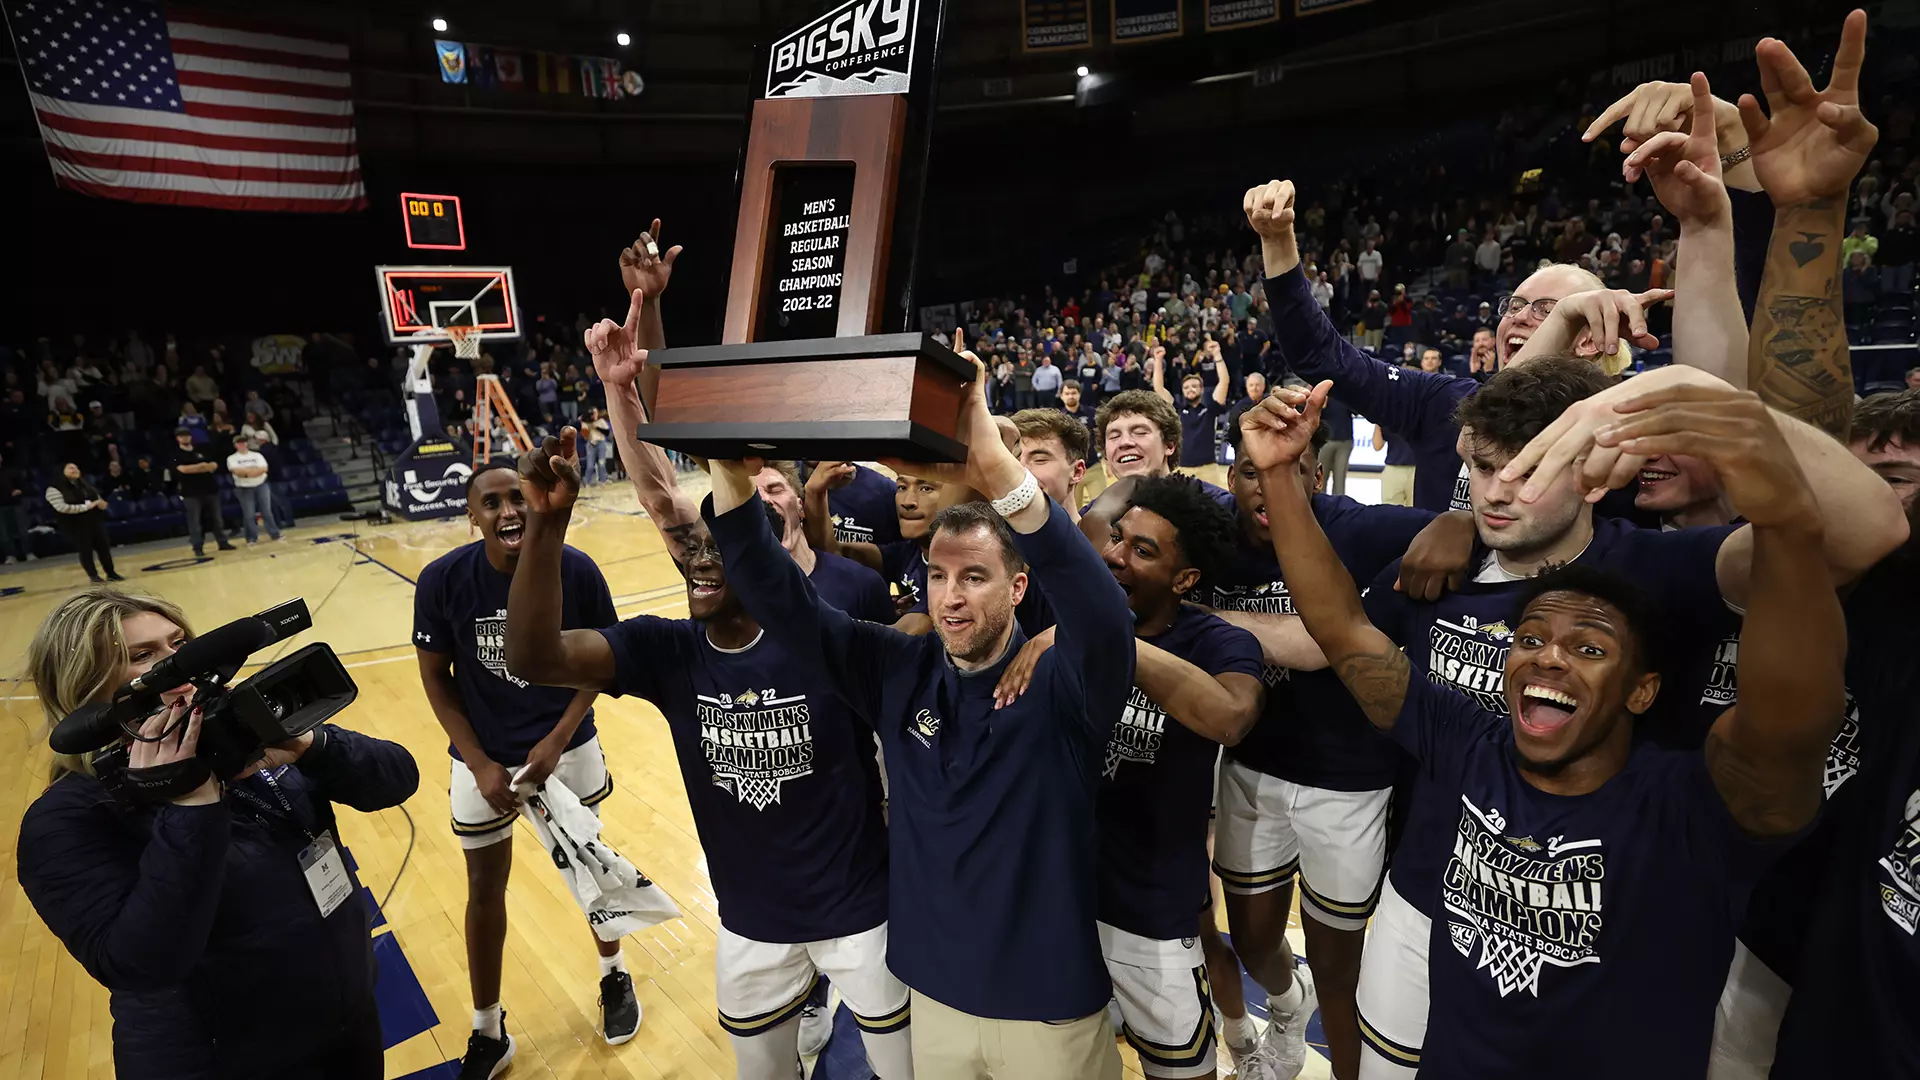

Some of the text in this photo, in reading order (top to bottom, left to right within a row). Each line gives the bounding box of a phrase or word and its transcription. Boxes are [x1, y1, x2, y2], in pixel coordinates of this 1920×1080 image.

[1116, 20, 1177, 36] CHAMPIONS
[825, 44, 905, 72] CONFERENCE
[803, 198, 836, 216] MEN'S
[783, 214, 850, 237] BASKETBALL
[789, 235, 840, 254] REGULAR
[791, 255, 834, 273] SEASON
[779, 273, 842, 292] CHAMPIONS
[782, 294, 833, 312] 2021-22
[424, 477, 458, 489] Security
[844, 517, 855, 525] 22
[1270, 581, 1284, 591] 22
[496, 608, 508, 617] 20
[475, 622, 499, 636] BIG
[1462, 614, 1478, 630] 20
[1460, 639, 1498, 668] SKY
[1429, 648, 1504, 692] BASKET
[720, 688, 777, 704] 20 22
[697, 703, 810, 732] BIG SKY MEN'S
[916, 708, 941, 733] Cats
[1116, 744, 1155, 759] BOBCATS
[745, 770, 771, 779] STATE
[773, 763, 811, 778] BOBCATS
[1485, 808, 1507, 832] 20
[1476, 831, 1605, 883] SKY MEN'S
[1451, 925, 1475, 945] SKY
[1493, 920, 1532, 946] STATE
[1536, 938, 1594, 960] BOBCATS
